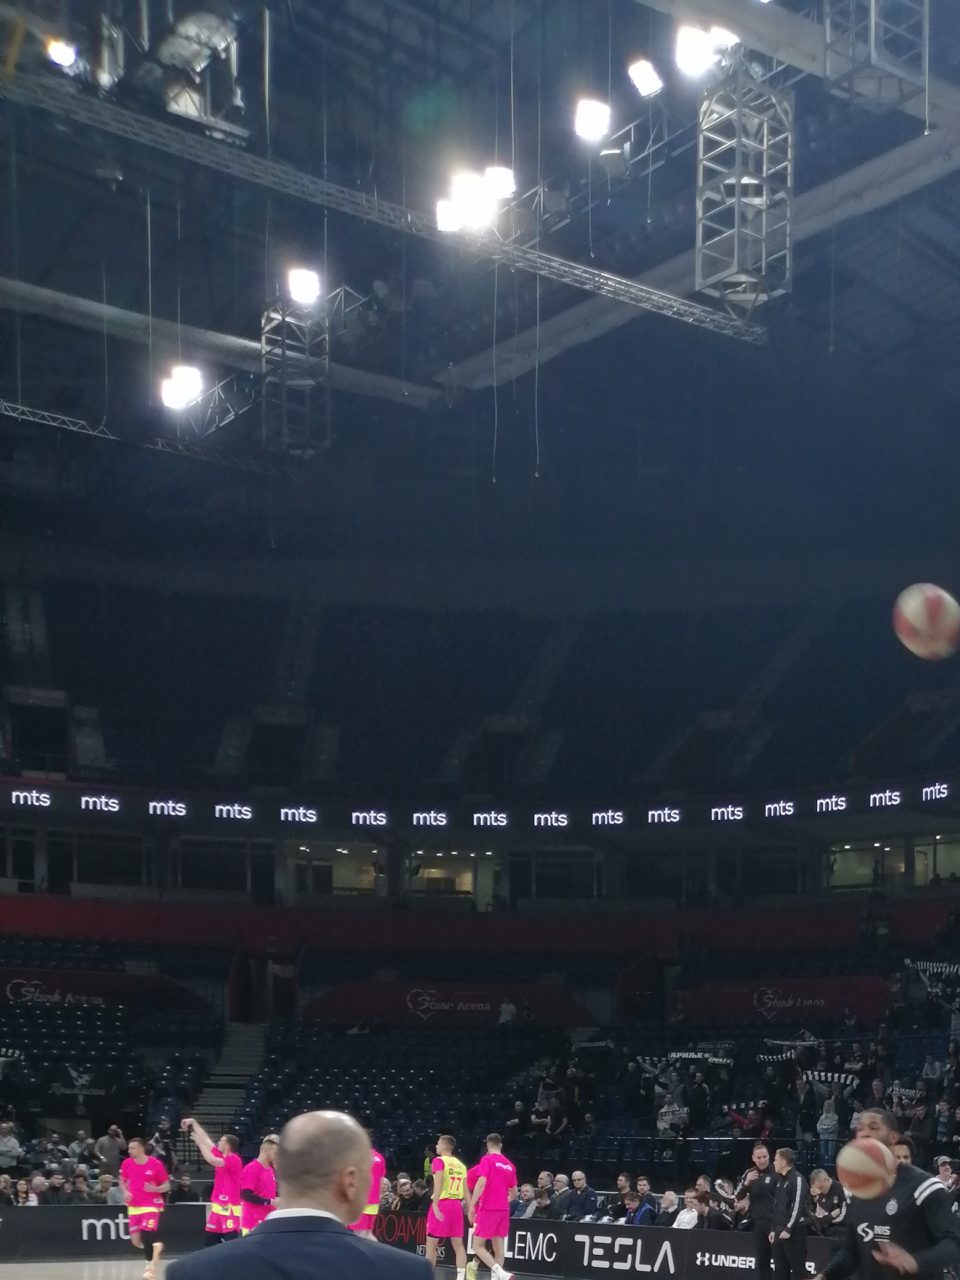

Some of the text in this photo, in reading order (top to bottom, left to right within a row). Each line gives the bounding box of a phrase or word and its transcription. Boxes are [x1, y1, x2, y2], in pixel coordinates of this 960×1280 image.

[12, 789, 51, 807] mts
[870, 789, 900, 807] mts
[923, 782, 948, 801] mts
[81, 795, 119, 812] mts
[149, 800, 186, 816] mts
[215, 803, 252, 819] mts
[765, 800, 794, 817] mts
[817, 794, 846, 812] mts
[281, 806, 317, 823] mts
[352, 809, 387, 826] mts
[413, 810, 447, 826] mts
[474, 811, 507, 826] mts
[534, 811, 568, 826] mts
[592, 810, 623, 825] mts
[648, 807, 680, 823] mts
[712, 805, 743, 820] mts
[450, 1176, 462, 1191] 77
[82, 1213, 131, 1241] mt
[226, 1219, 233, 1229] 6
[574, 1234, 675, 1274] TESLA
[711, 1254, 756, 1270] UNDER
